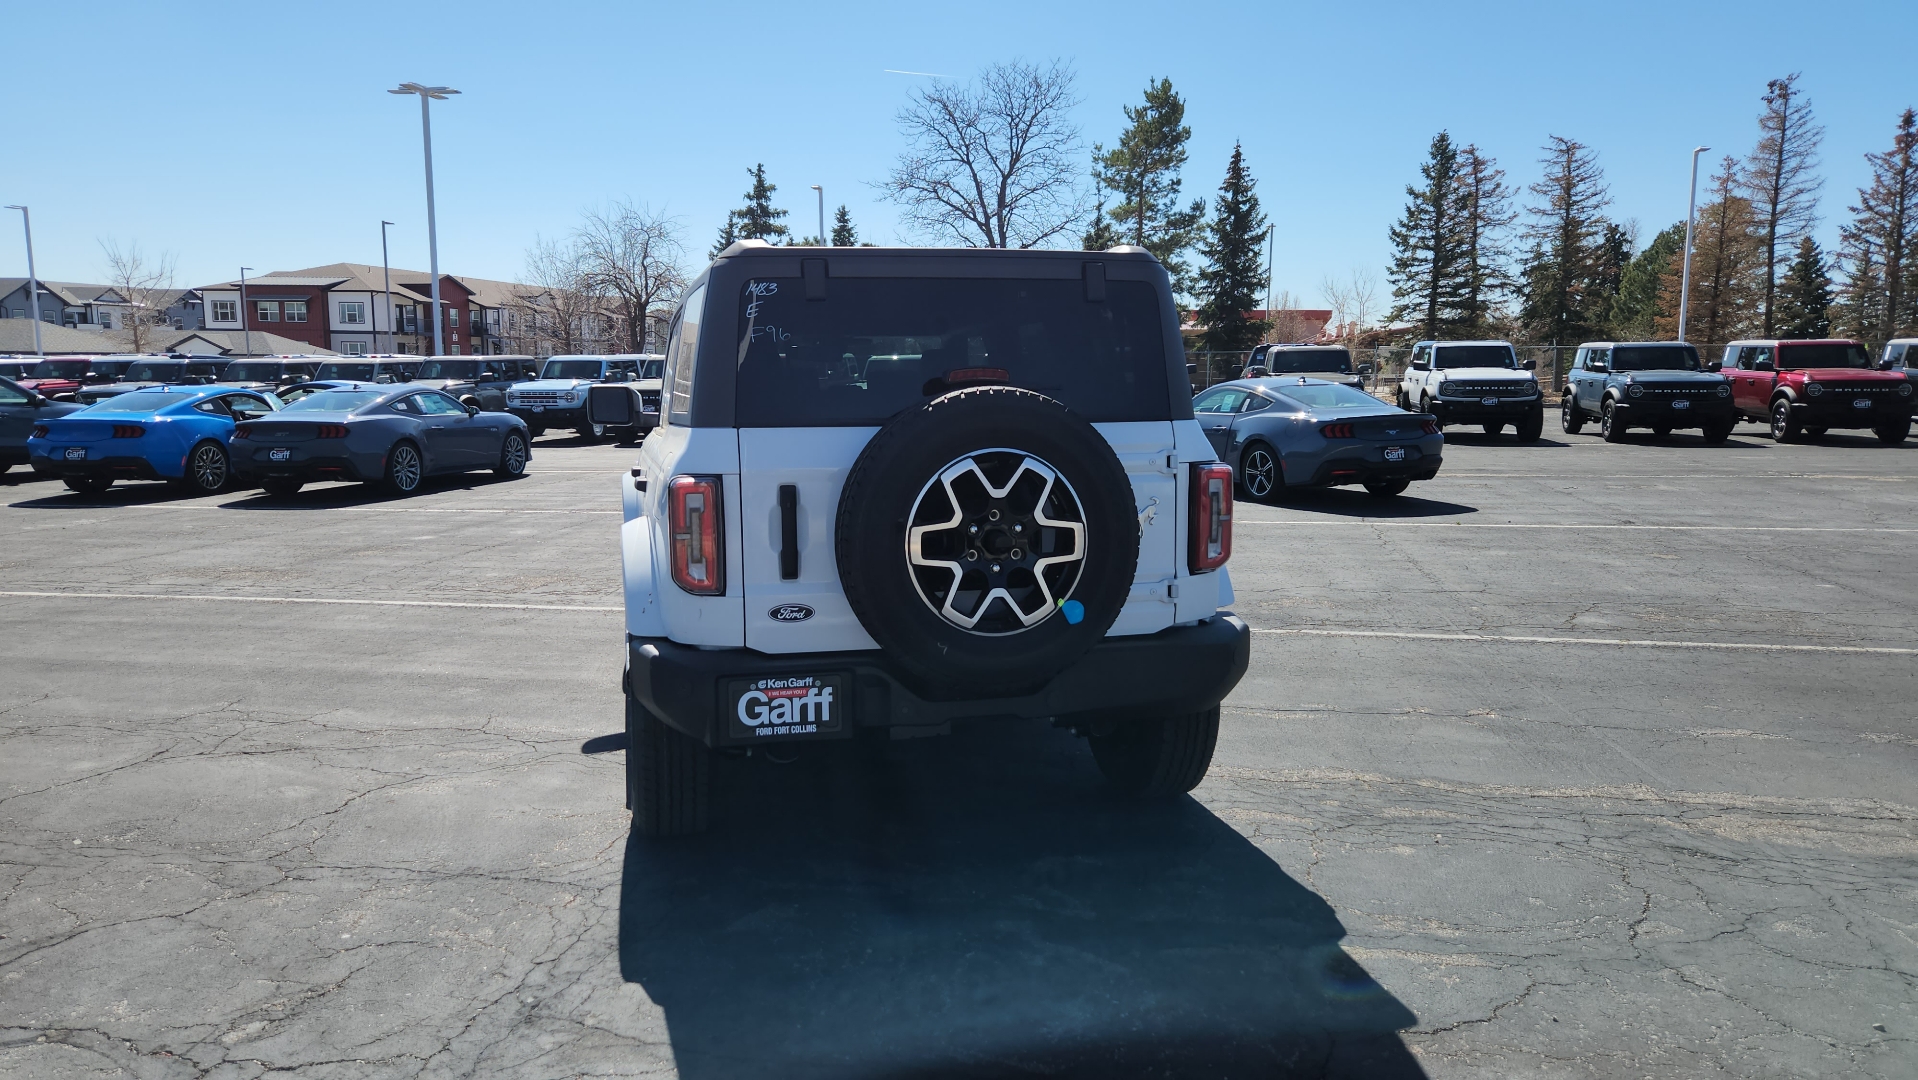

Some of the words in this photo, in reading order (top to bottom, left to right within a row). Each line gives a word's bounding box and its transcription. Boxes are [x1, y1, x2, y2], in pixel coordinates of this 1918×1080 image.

[751, 325, 791, 342] F96
[65, 449, 86, 459] Garff
[269, 450, 290, 459] Garff
[1384, 448, 1405, 459] Garff
[777, 607, 806, 619] Ford
[767, 678, 788, 689] Ken
[788, 677, 814, 687] Garff
[737, 687, 833, 727] Garff
[756, 726, 773, 736] FORD
[774, 725, 790, 735] FORT
[791, 724, 817, 734] COLLINS
